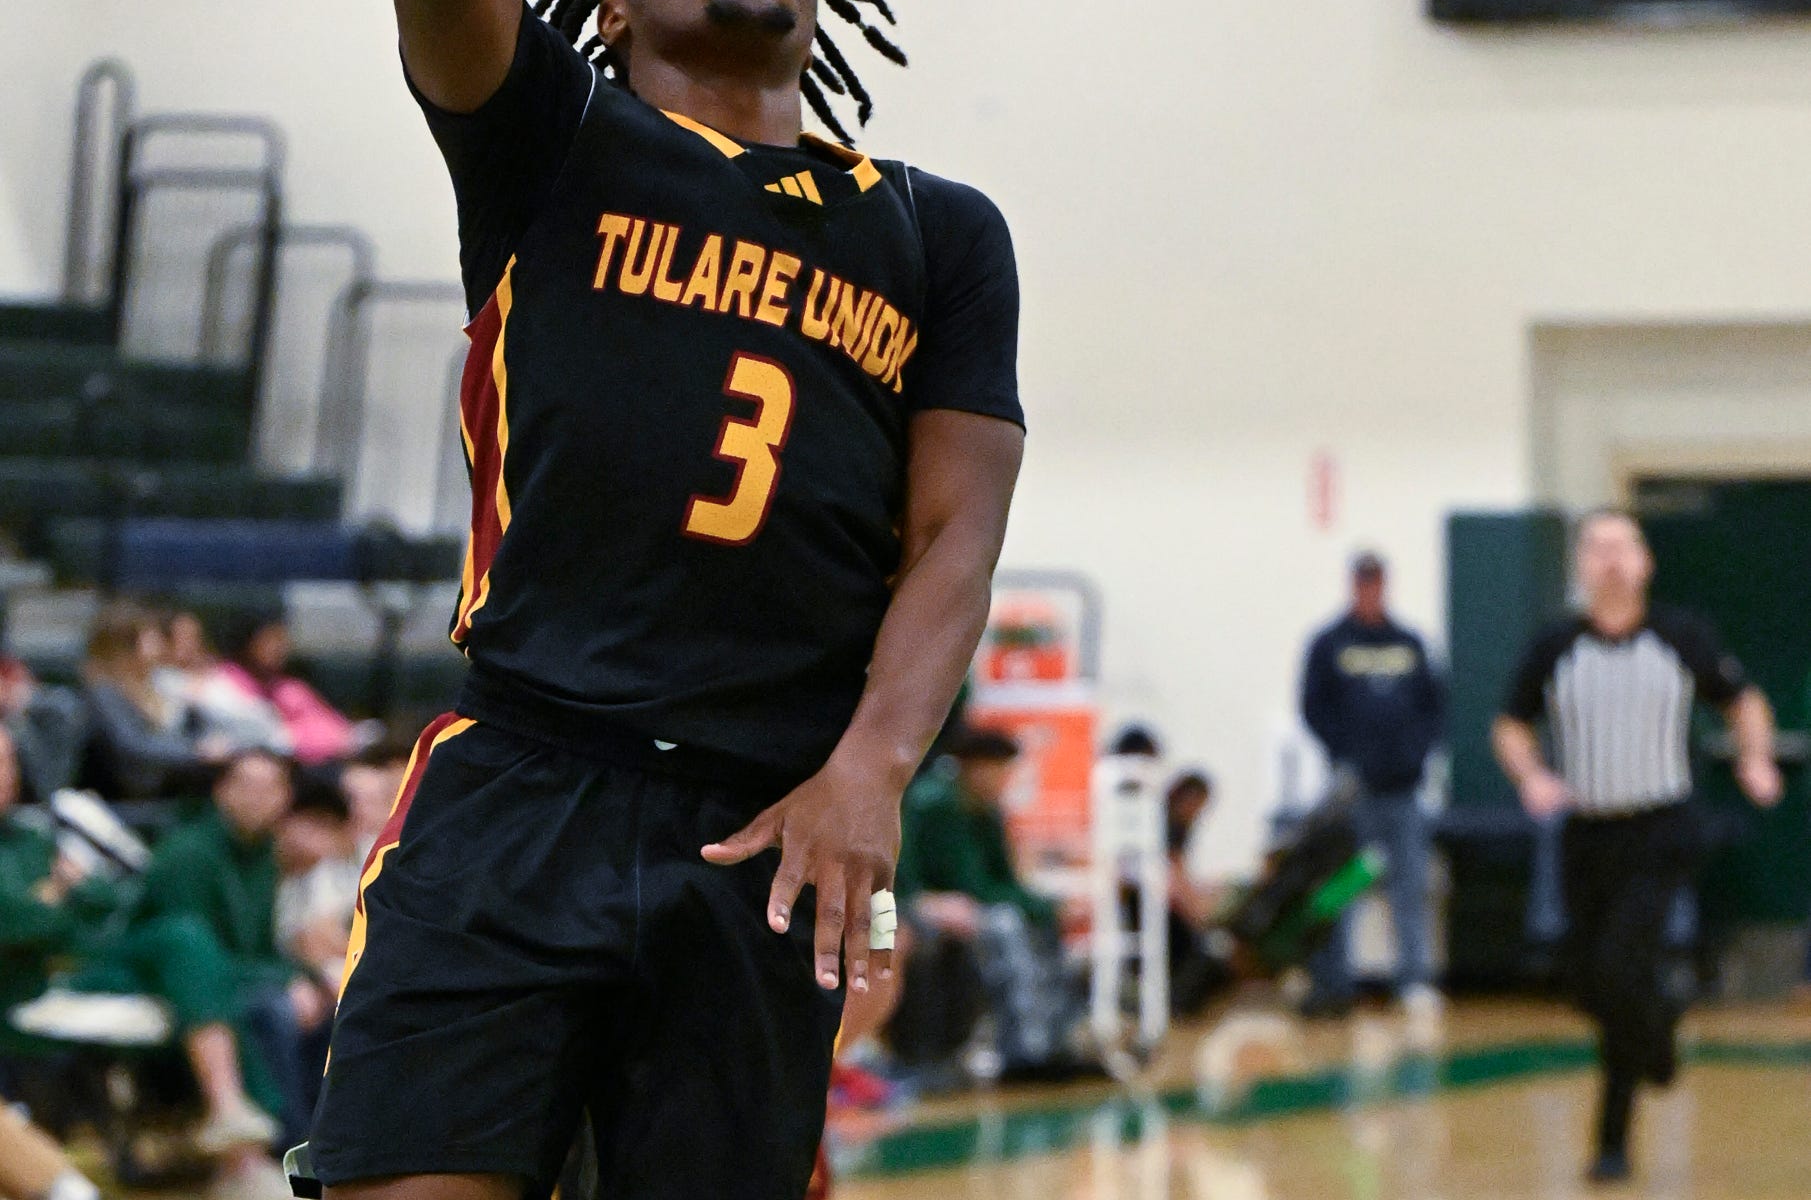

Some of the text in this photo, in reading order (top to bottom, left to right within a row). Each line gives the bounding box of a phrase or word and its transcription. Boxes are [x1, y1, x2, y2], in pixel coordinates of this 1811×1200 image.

[592, 212, 918, 393] TULARE UNION
[682, 351, 796, 547] 3
